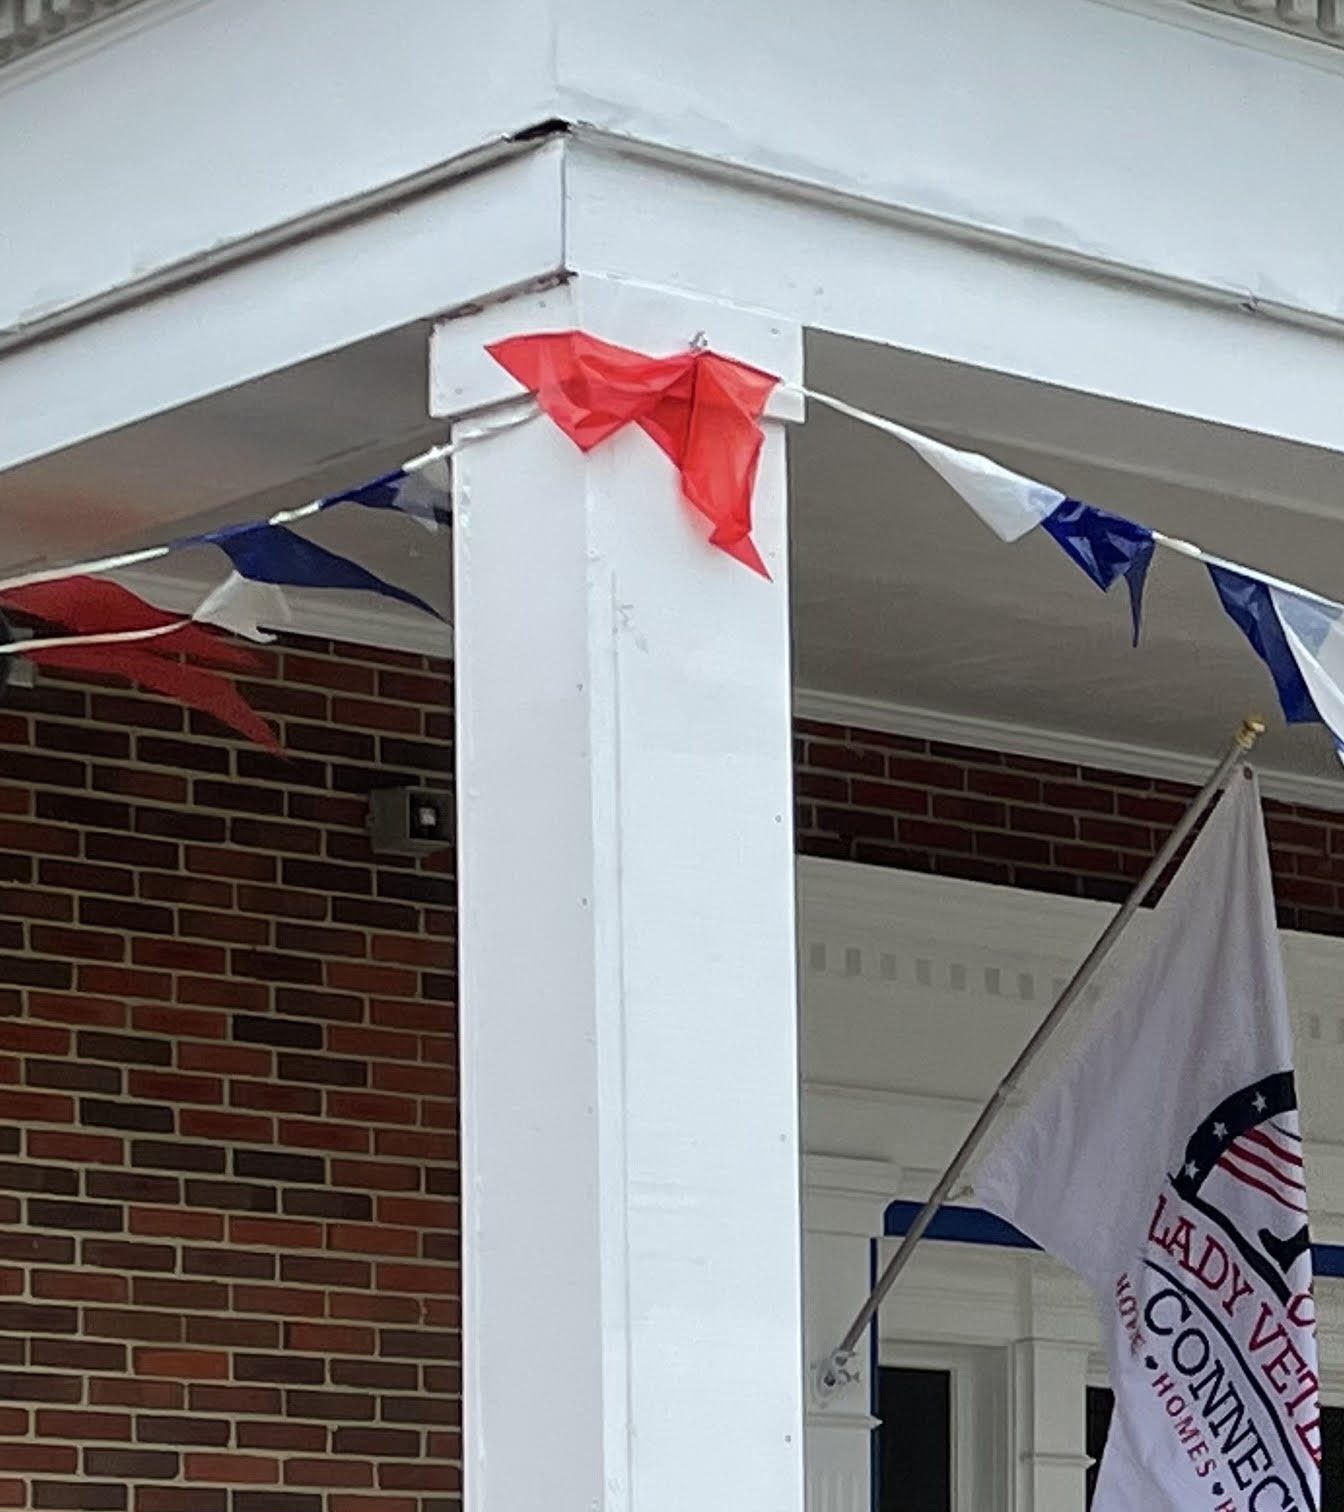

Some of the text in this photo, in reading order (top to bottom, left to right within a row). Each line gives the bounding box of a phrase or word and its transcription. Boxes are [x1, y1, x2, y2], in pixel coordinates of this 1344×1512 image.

[1148, 1193, 1323, 1472] LADY VETE
[1151, 1371, 1217, 1478] HOMES
